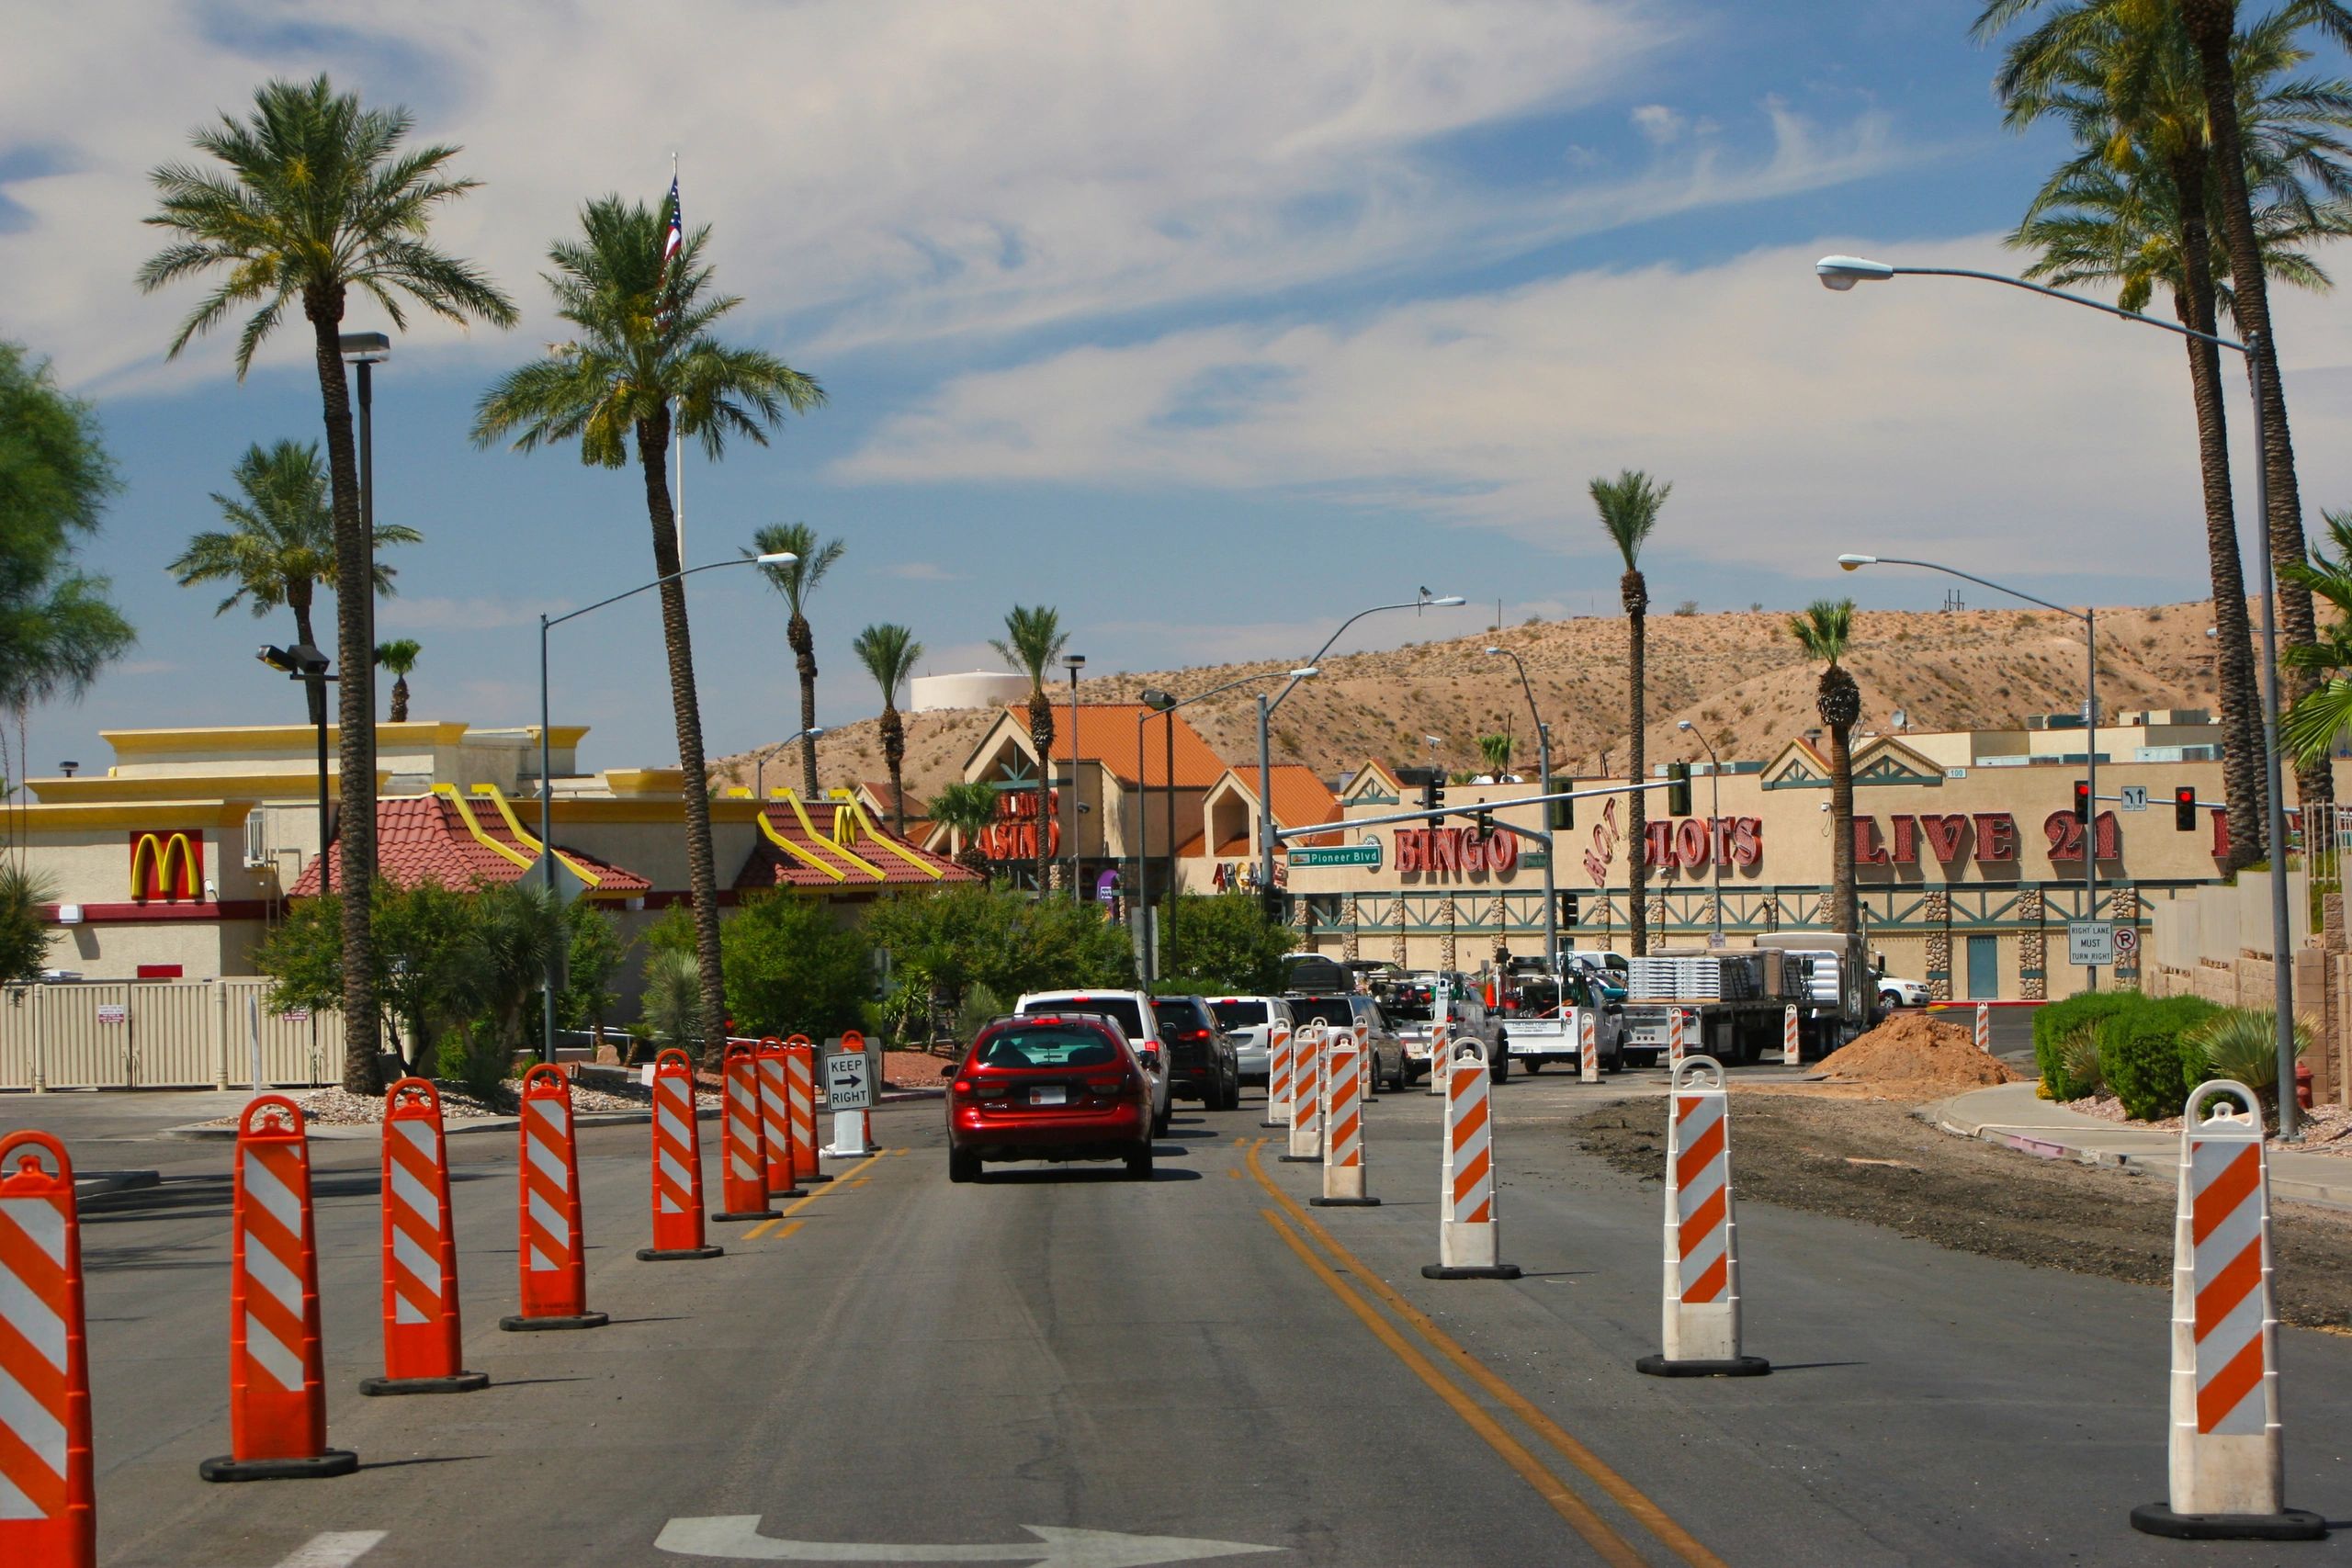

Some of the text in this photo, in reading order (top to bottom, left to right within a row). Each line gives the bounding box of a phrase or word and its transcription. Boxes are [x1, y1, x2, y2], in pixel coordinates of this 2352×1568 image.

[1853, 810, 2118, 864] LIVE 21
[1394, 826, 1518, 872] BINGO
[1311, 852, 1376, 863] Pioneer Blvd
[1212, 862, 1288, 888] ARCAE
[2081, 939, 2100, 948] MUST
[831, 1060, 862, 1073] KEEP
[831, 1090, 866, 1103] RIGHT
